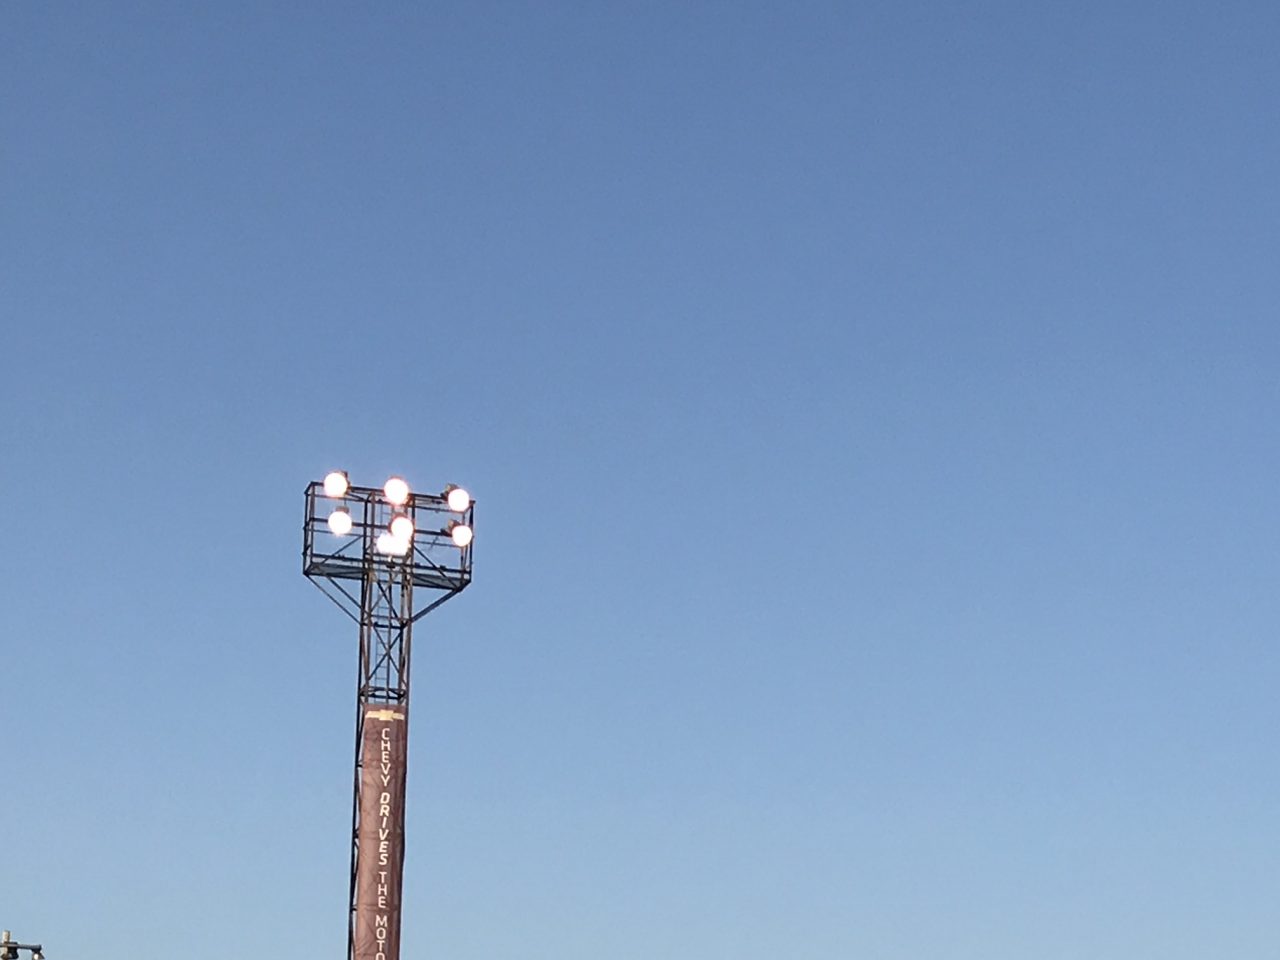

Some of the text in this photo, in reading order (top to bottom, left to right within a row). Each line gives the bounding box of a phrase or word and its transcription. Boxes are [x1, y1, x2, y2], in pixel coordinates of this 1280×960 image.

[380, 727, 391, 787] CHEVY
[378, 792, 390, 866] DRIVES
[377, 871, 388, 909] THE
